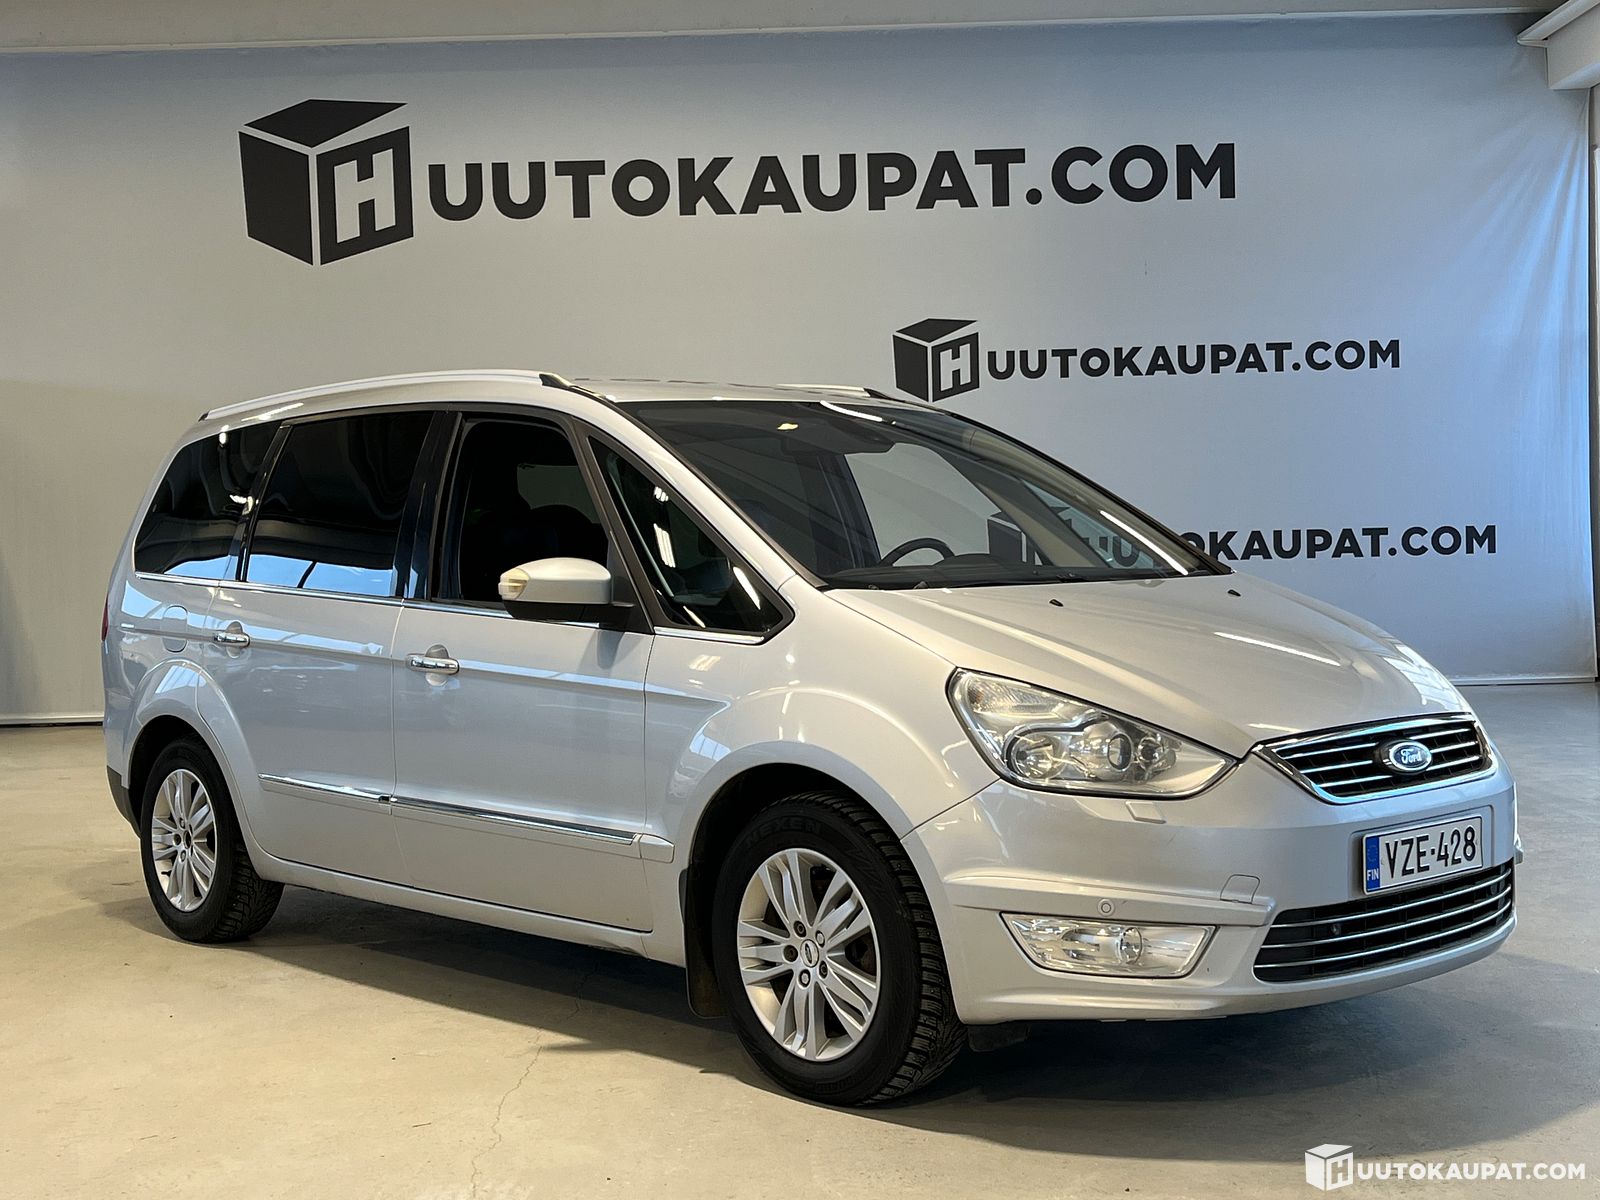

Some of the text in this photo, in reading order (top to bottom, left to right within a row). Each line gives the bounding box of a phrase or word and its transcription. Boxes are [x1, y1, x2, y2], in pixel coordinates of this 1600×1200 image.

[1401, 748, 1422, 764] Ford
[1385, 826, 1477, 879] VZE-428
[1366, 868, 1380, 881] FIN
